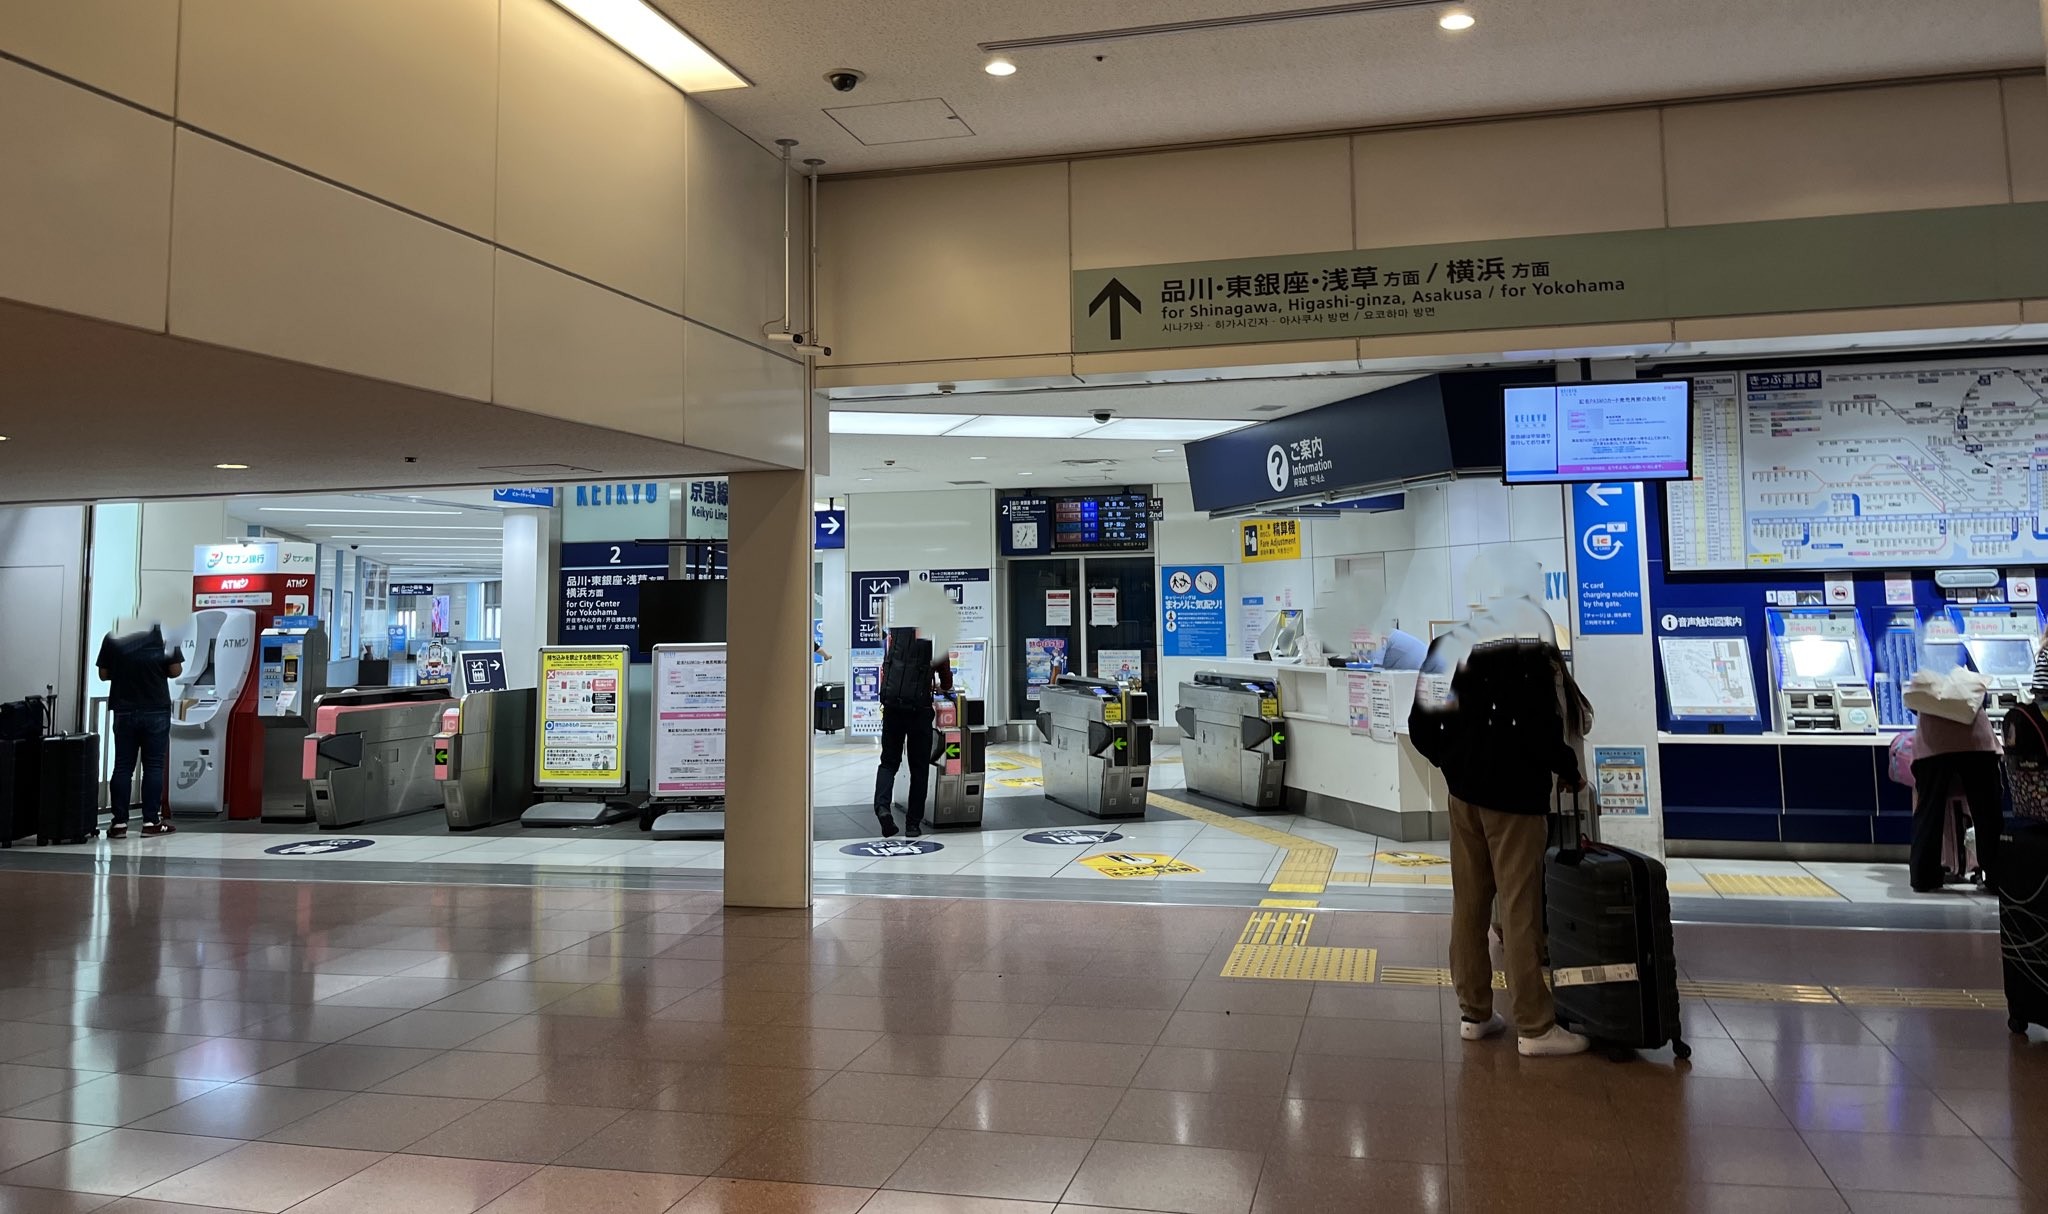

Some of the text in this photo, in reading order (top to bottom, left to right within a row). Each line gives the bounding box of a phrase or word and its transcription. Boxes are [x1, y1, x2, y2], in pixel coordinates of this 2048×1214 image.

[1162, 305, 1184, 319] for
[1190, 301, 1283, 319] Shinagawa,
[1289, 292, 1406, 314] Higashi-ginza,
[1412, 286, 1482, 303] Asakusa
[1502, 284, 1526, 298] for
[1533, 278, 1625, 296] Yokohama
[1162, 320, 1204, 332] 시나가와
[1215, 317, 1269, 329] 히가시긴자
[1279, 313, 1324, 325] 아사쿠사
[1328, 310, 1350, 322] 방면
[1364, 307, 1408, 320] 요코하마
[1413, 306, 1436, 318] 방면
[1290, 436, 1324, 461] ご案内
[1292, 459, 1333, 476] Information
[576, 483, 657, 507] KEIKYU
[715, 508, 728, 521] Line
[1002, 505, 1009, 515] 2
[226, 553, 265, 564] セブン銀行
[609, 545, 622, 564] 2
[221, 578, 249, 590] ATM
[286, 578, 308, 588] ATM
[566, 587, 604, 598] 横浜方面
[1583, 590, 1639, 599] charging machine
[566, 600, 621, 610] for City Center
[1583, 600, 1592, 608] by
[566, 608, 618, 616] for Yokohama
[223, 638, 248, 648] ATM
[940, 713, 954, 724] IC
[444, 719, 456, 731] IC
